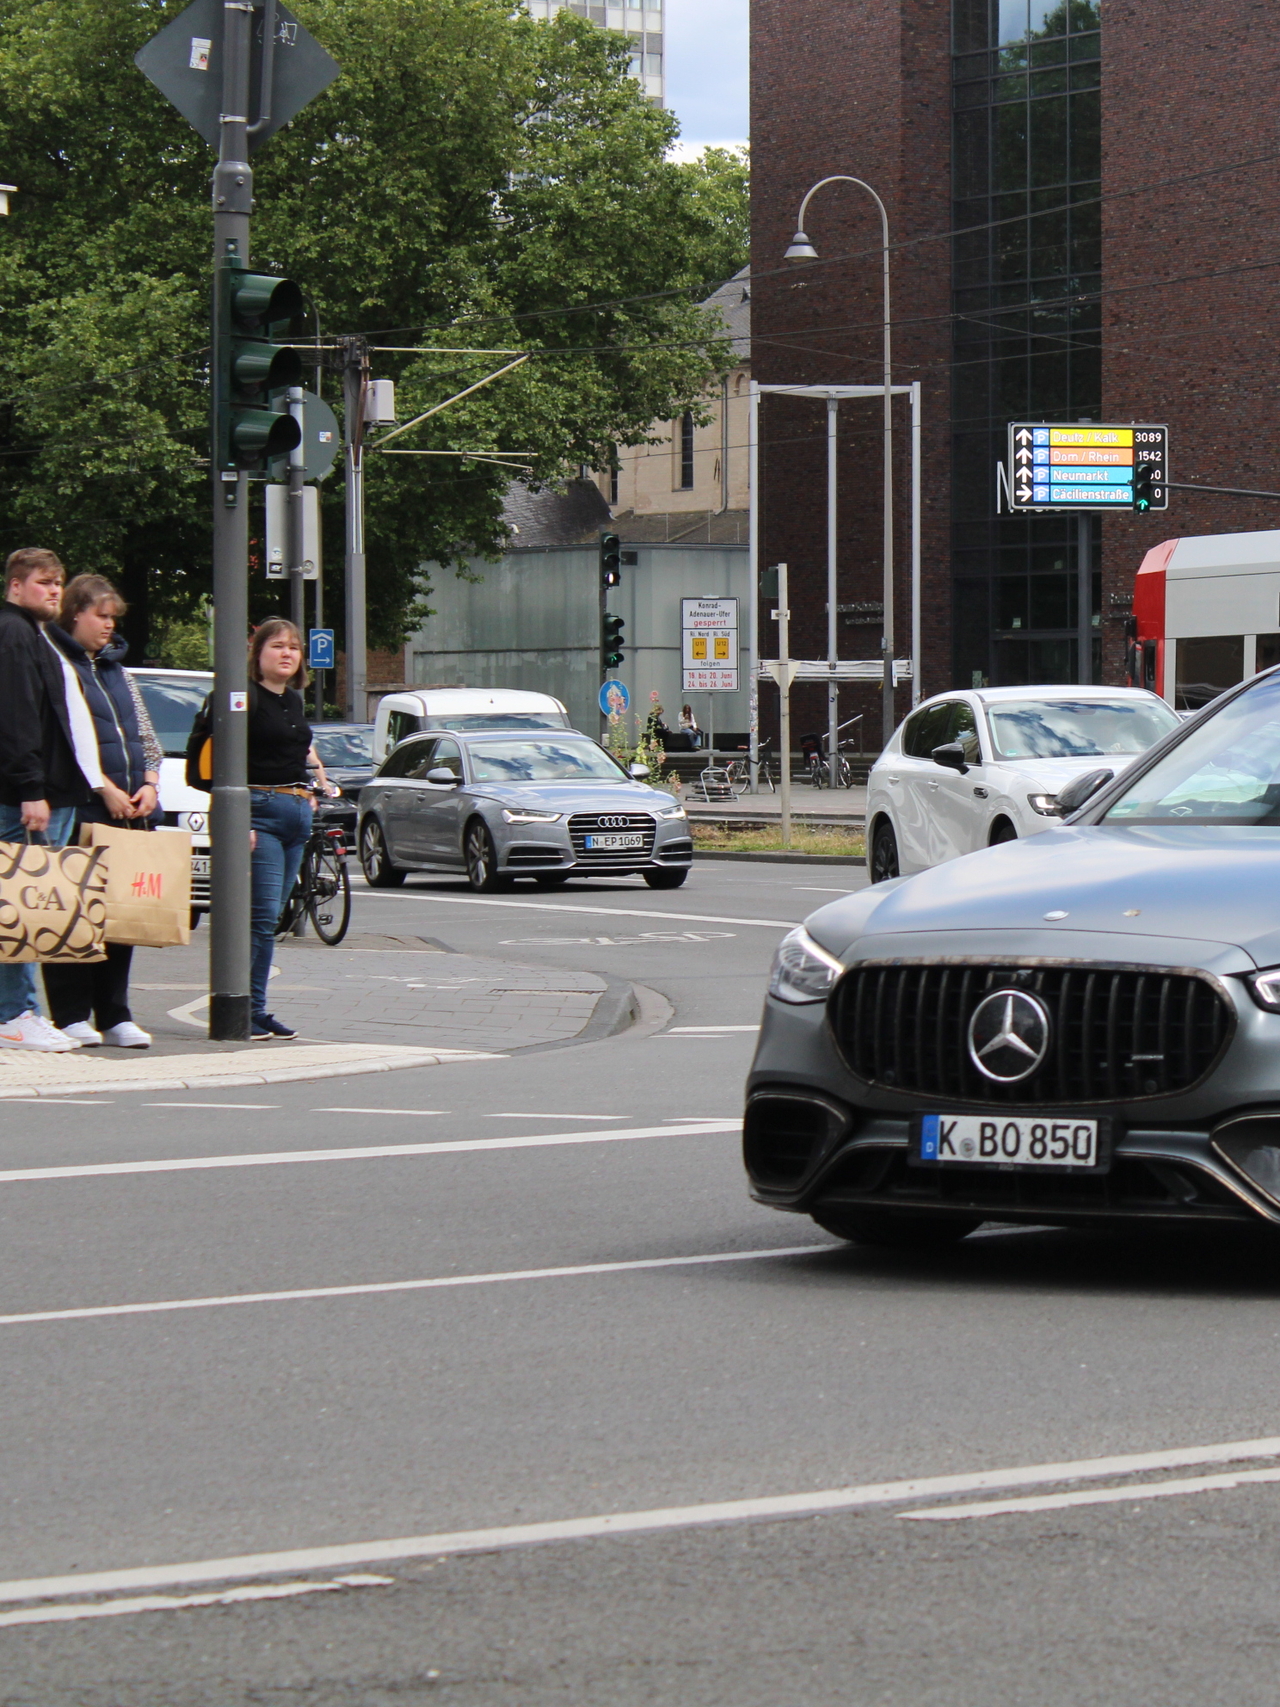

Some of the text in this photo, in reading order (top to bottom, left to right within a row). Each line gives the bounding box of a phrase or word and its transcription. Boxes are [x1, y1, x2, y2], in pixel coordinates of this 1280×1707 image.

[1053, 431, 1084, 442] Deutz
[1094, 432, 1118, 443] Kalk
[1135, 432, 1161, 442] 3089
[1053, 451, 1078, 462] Dom
[1088, 451, 1119, 462] Rhein
[1138, 451, 1161, 461] 1542
[1053, 470, 1108, 481] Neumarkt
[1053, 488, 1129, 500] Cäcilienstraße
[1154, 488, 1161, 498] 0
[694, 620, 726, 628] gesperrt
[317, 639, 328, 653] P
[721, 671, 732, 679] Juni
[592, 836, 641, 846] N EP 1069
[131, 872, 162, 899] H&M
[20, 886, 66, 911] C&A
[939, 1121, 1092, 1160] K BO 850
